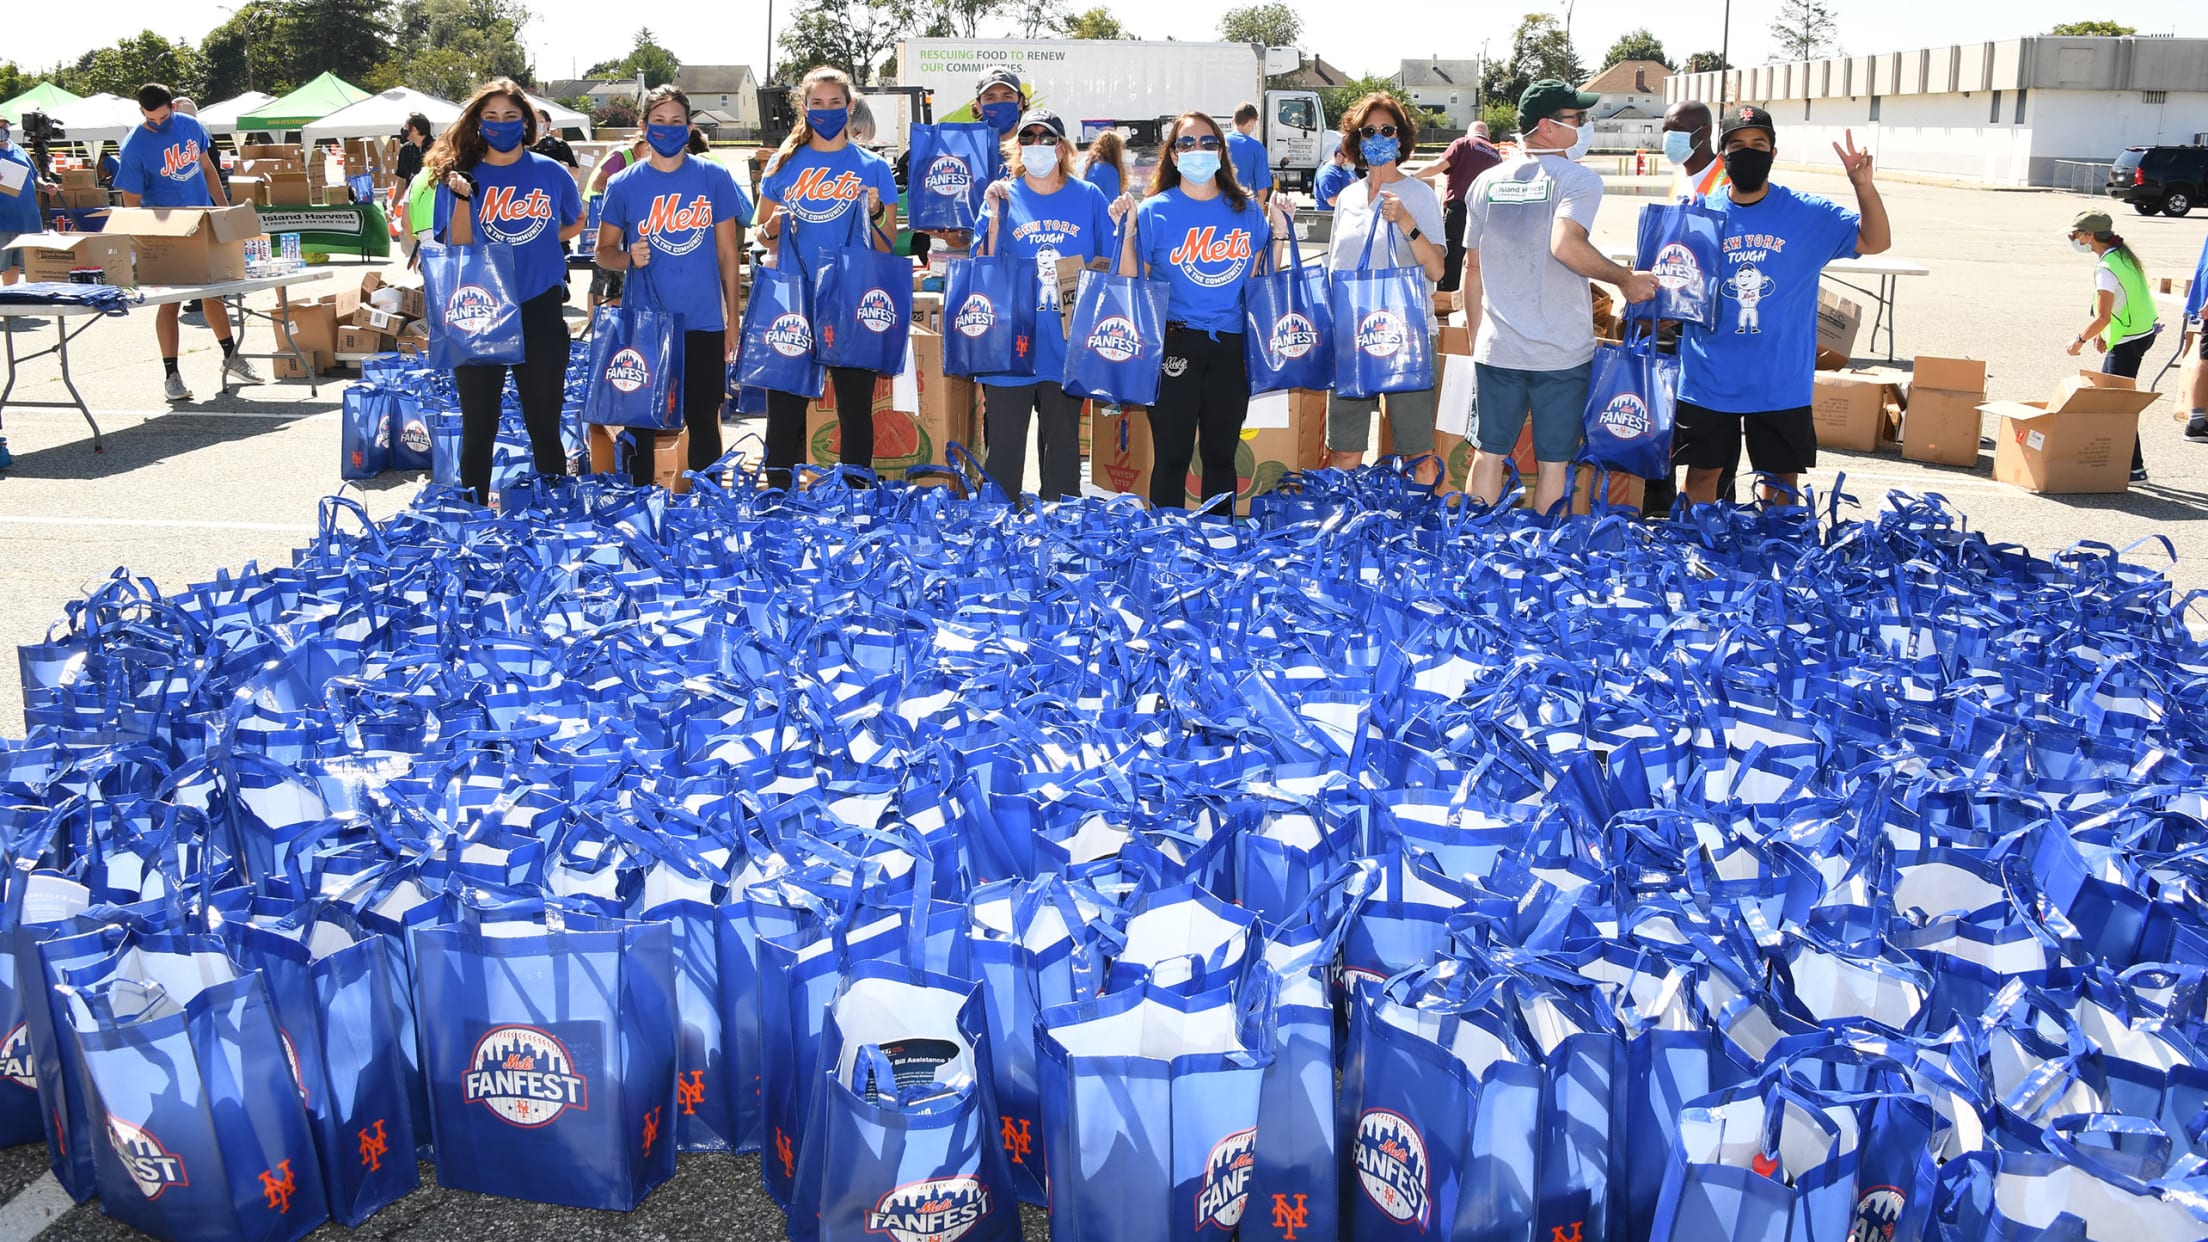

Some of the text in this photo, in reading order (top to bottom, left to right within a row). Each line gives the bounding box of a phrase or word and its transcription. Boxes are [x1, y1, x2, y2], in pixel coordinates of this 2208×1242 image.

[920, 50, 1066, 61] RESCUING FOOD TO RENEW
[920, 63, 1026, 73] OUR COMMES.
[784, 167, 862, 203] Mets
[925, 174, 972, 188] FANFEST
[479, 186, 552, 224] Mets
[638, 193, 712, 236] Mets
[796, 208, 807, 218] THE
[808, 201, 847, 220] COMMUNITY
[262, 212, 355, 222] Island Harvest
[493, 232, 506, 242] THE
[506, 221, 543, 243] COMMUNITY
[1012, 219, 1080, 241] NEW YORK
[1028, 233, 1064, 244] TOUGH
[1170, 225, 1251, 265] Mets
[1722, 234, 1786, 253] EW YORK
[1728, 249, 1767, 264] TOUGH
[1192, 272, 1204, 282] THE
[1205, 260, 1243, 285] COMMUNITY
[445, 305, 498, 323] FANFEST
[857, 307, 897, 325] FANFEST
[955, 313, 995, 329] FANFEST
[765, 330, 813, 350] FANFEST
[1087, 335, 1142, 355] FANFEST
[1269, 332, 1318, 350] FANFEST
[606, 367, 650, 385] FANFEST
[1600, 412, 1651, 433] FANFEST
[502, 1054, 535, 1071] Mets
[907, 1056, 945, 1064] Assistance
[467, 1070, 582, 1104] FANFEST
[357, 1118, 389, 1172] NY
[1000, 1115, 1032, 1164] NY
[1379, 1137, 1407, 1164] Mets
[258, 1158, 297, 1214] NY
[1353, 1138, 1429, 1223] FANFEST
[1199, 1165, 1253, 1224] FANF
[870, 1191, 988, 1232] FANFEST
[915, 1198, 953, 1214] Mets
[1271, 1193, 1308, 1240] NY
